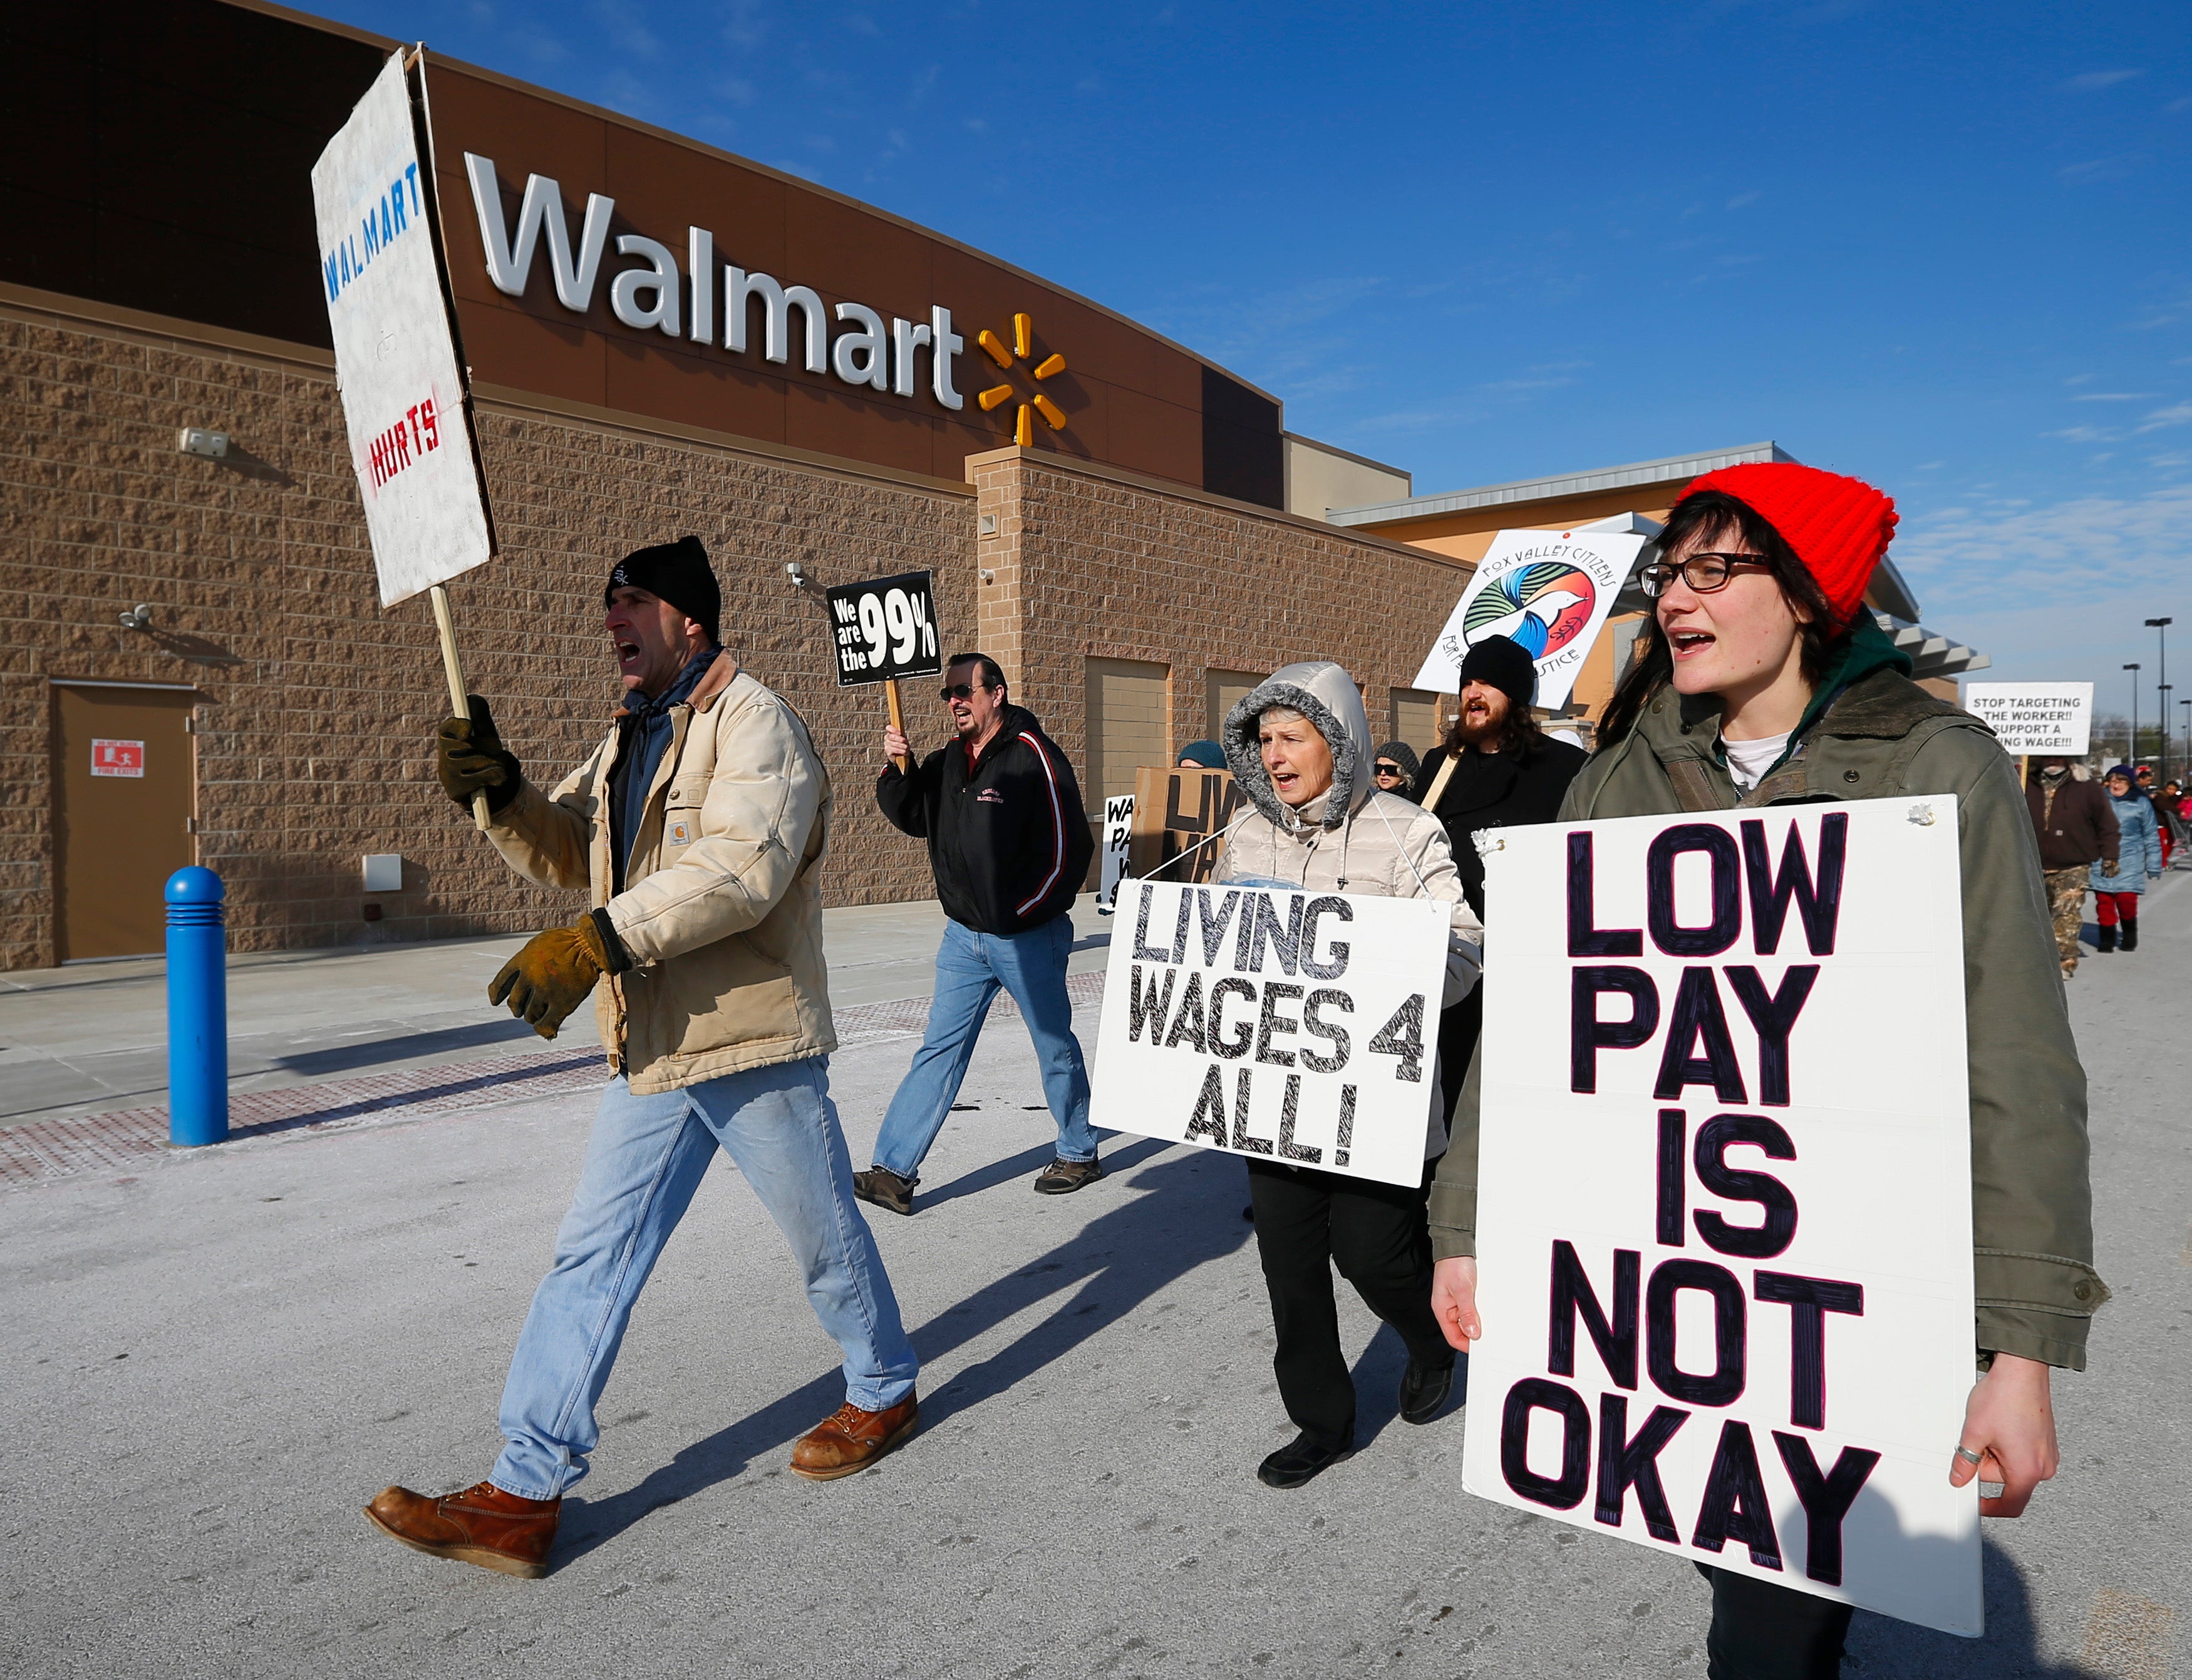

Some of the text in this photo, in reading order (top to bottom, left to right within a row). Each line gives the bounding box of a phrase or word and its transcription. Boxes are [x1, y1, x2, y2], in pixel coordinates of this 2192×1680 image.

[324, 162, 418, 302] WALMART
[463, 151, 963, 411] Walmart
[370, 398, 439, 487] HURTS
[1482, 545, 1617, 587] FOX VALLEY CITIZENS
[834, 598, 857, 623] We
[837, 625, 861, 645] are
[859, 588, 936, 667] 99%
[1442, 635, 1459, 657] FOR
[840, 647, 867, 672] the
[1974, 698, 2081, 708] STOP TARGETING
[1984, 711, 2072, 721] THE WORKER!!
[1993, 724, 2061, 734] SUPPORT A
[1997, 738, 2072, 747] ING WAGE!!!
[1109, 798, 1134, 823] WA
[1566, 812, 1848, 957] LOW
[1132, 885, 1353, 980] LIVING
[1129, 965, 1425, 1082] WAGES 4
[1571, 964, 1820, 1106] PAY
[1184, 1064, 1357, 1167] ALL!
[1656, 1108, 1798, 1259] IS
[1548, 1239, 1864, 1430] NOT
[1501, 1376, 1881, 1587] OKAY
